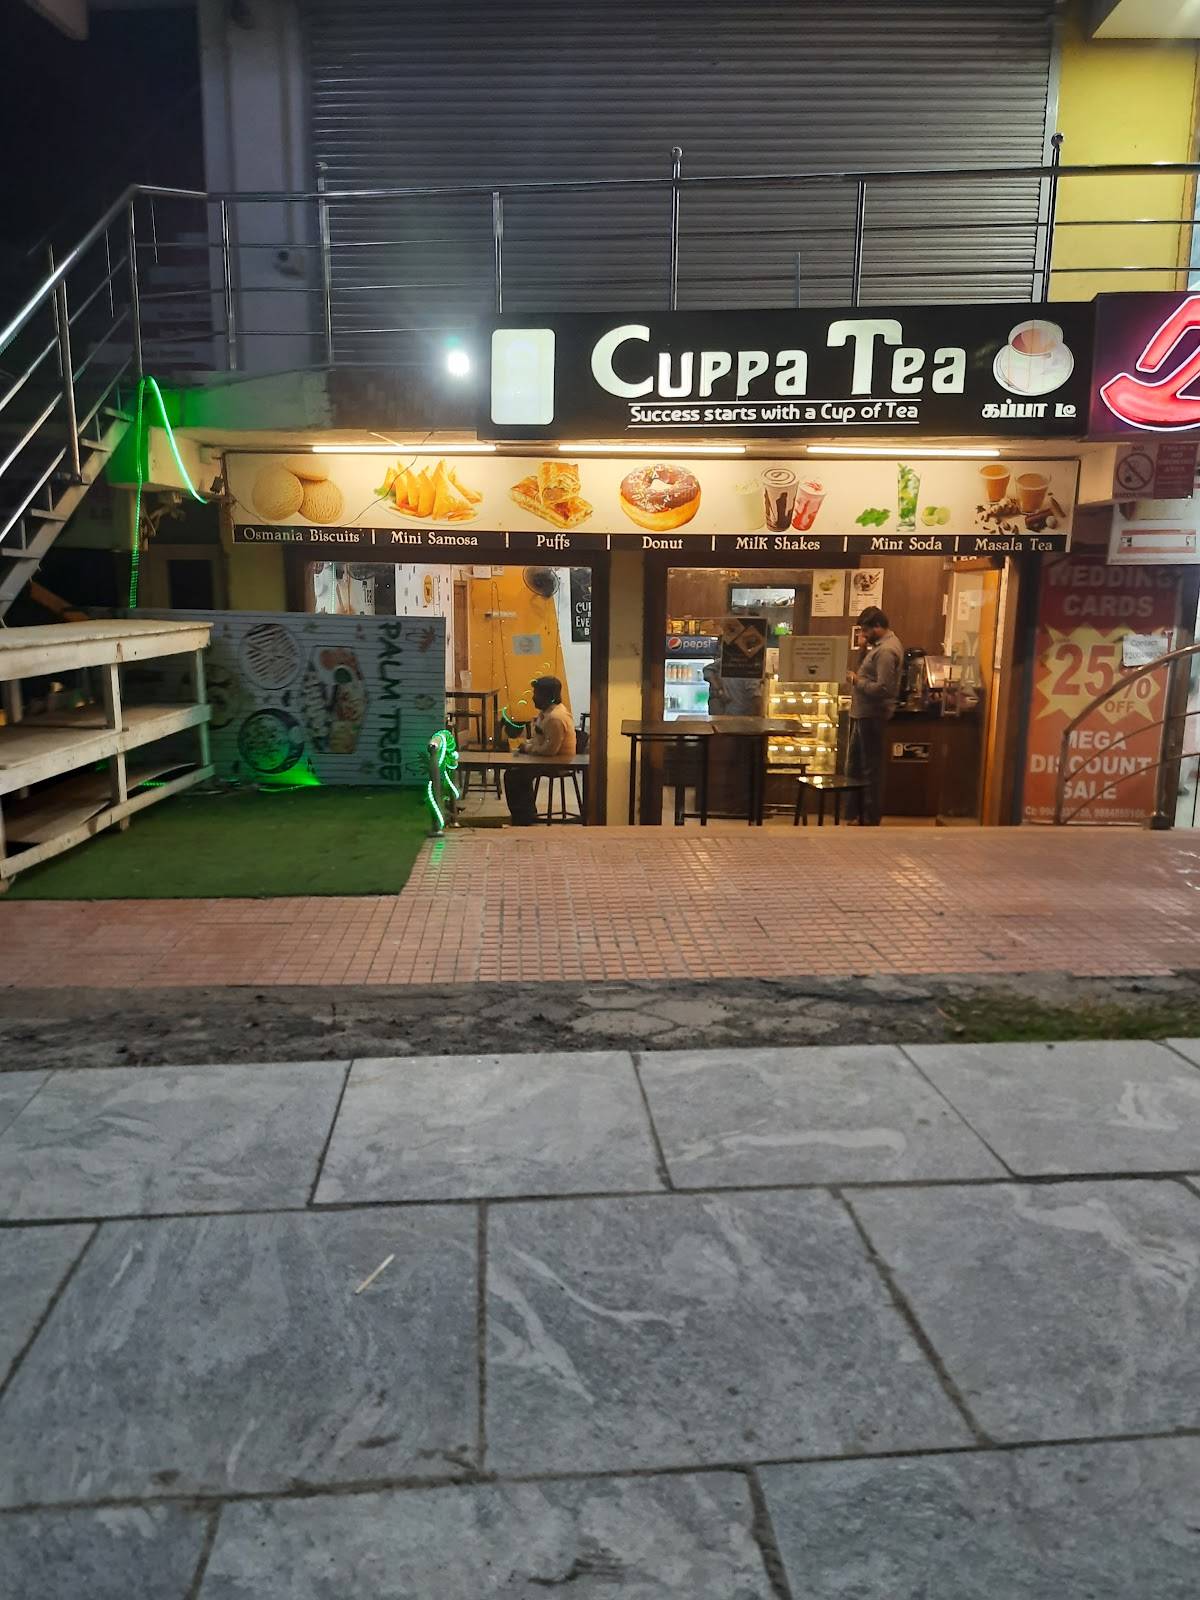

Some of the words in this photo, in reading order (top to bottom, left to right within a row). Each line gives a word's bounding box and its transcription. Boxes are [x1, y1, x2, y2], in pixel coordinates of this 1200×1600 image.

[827, 319, 966, 395] Tea
[630, 406, 701, 422] Success
[703, 406, 757, 421] starts
[760, 404, 801, 420] with
[804, 408, 817, 420] a
[820, 403, 856, 423] Cup
[860, 403, 883, 419] of
[884, 402, 919, 419] Tea
[981, 398, 1049, 419] கப்பா
[243, 527, 304, 541] Osmania
[309, 528, 360, 543] Biscuits
[390, 530, 423, 545] Mini
[427, 531, 479, 546] Samosa
[536, 533, 571, 550] Puffs
[642, 535, 684, 550] Donut
[774, 536, 821, 551] Shakes
[870, 537, 904, 550] Mint
[908, 536, 942, 551] Soda
[974, 537, 1023, 551] Masala
[1030, 538, 1053, 551] Tea
[1048, 563, 1175, 588] WEDDING
[1063, 594, 1155, 617] CARDS
[682, 638, 712, 650] pepsi
[377, 622, 403, 701] PALM
[1105, 700, 1135, 713] OFF
[378, 708, 402, 782] TREE
